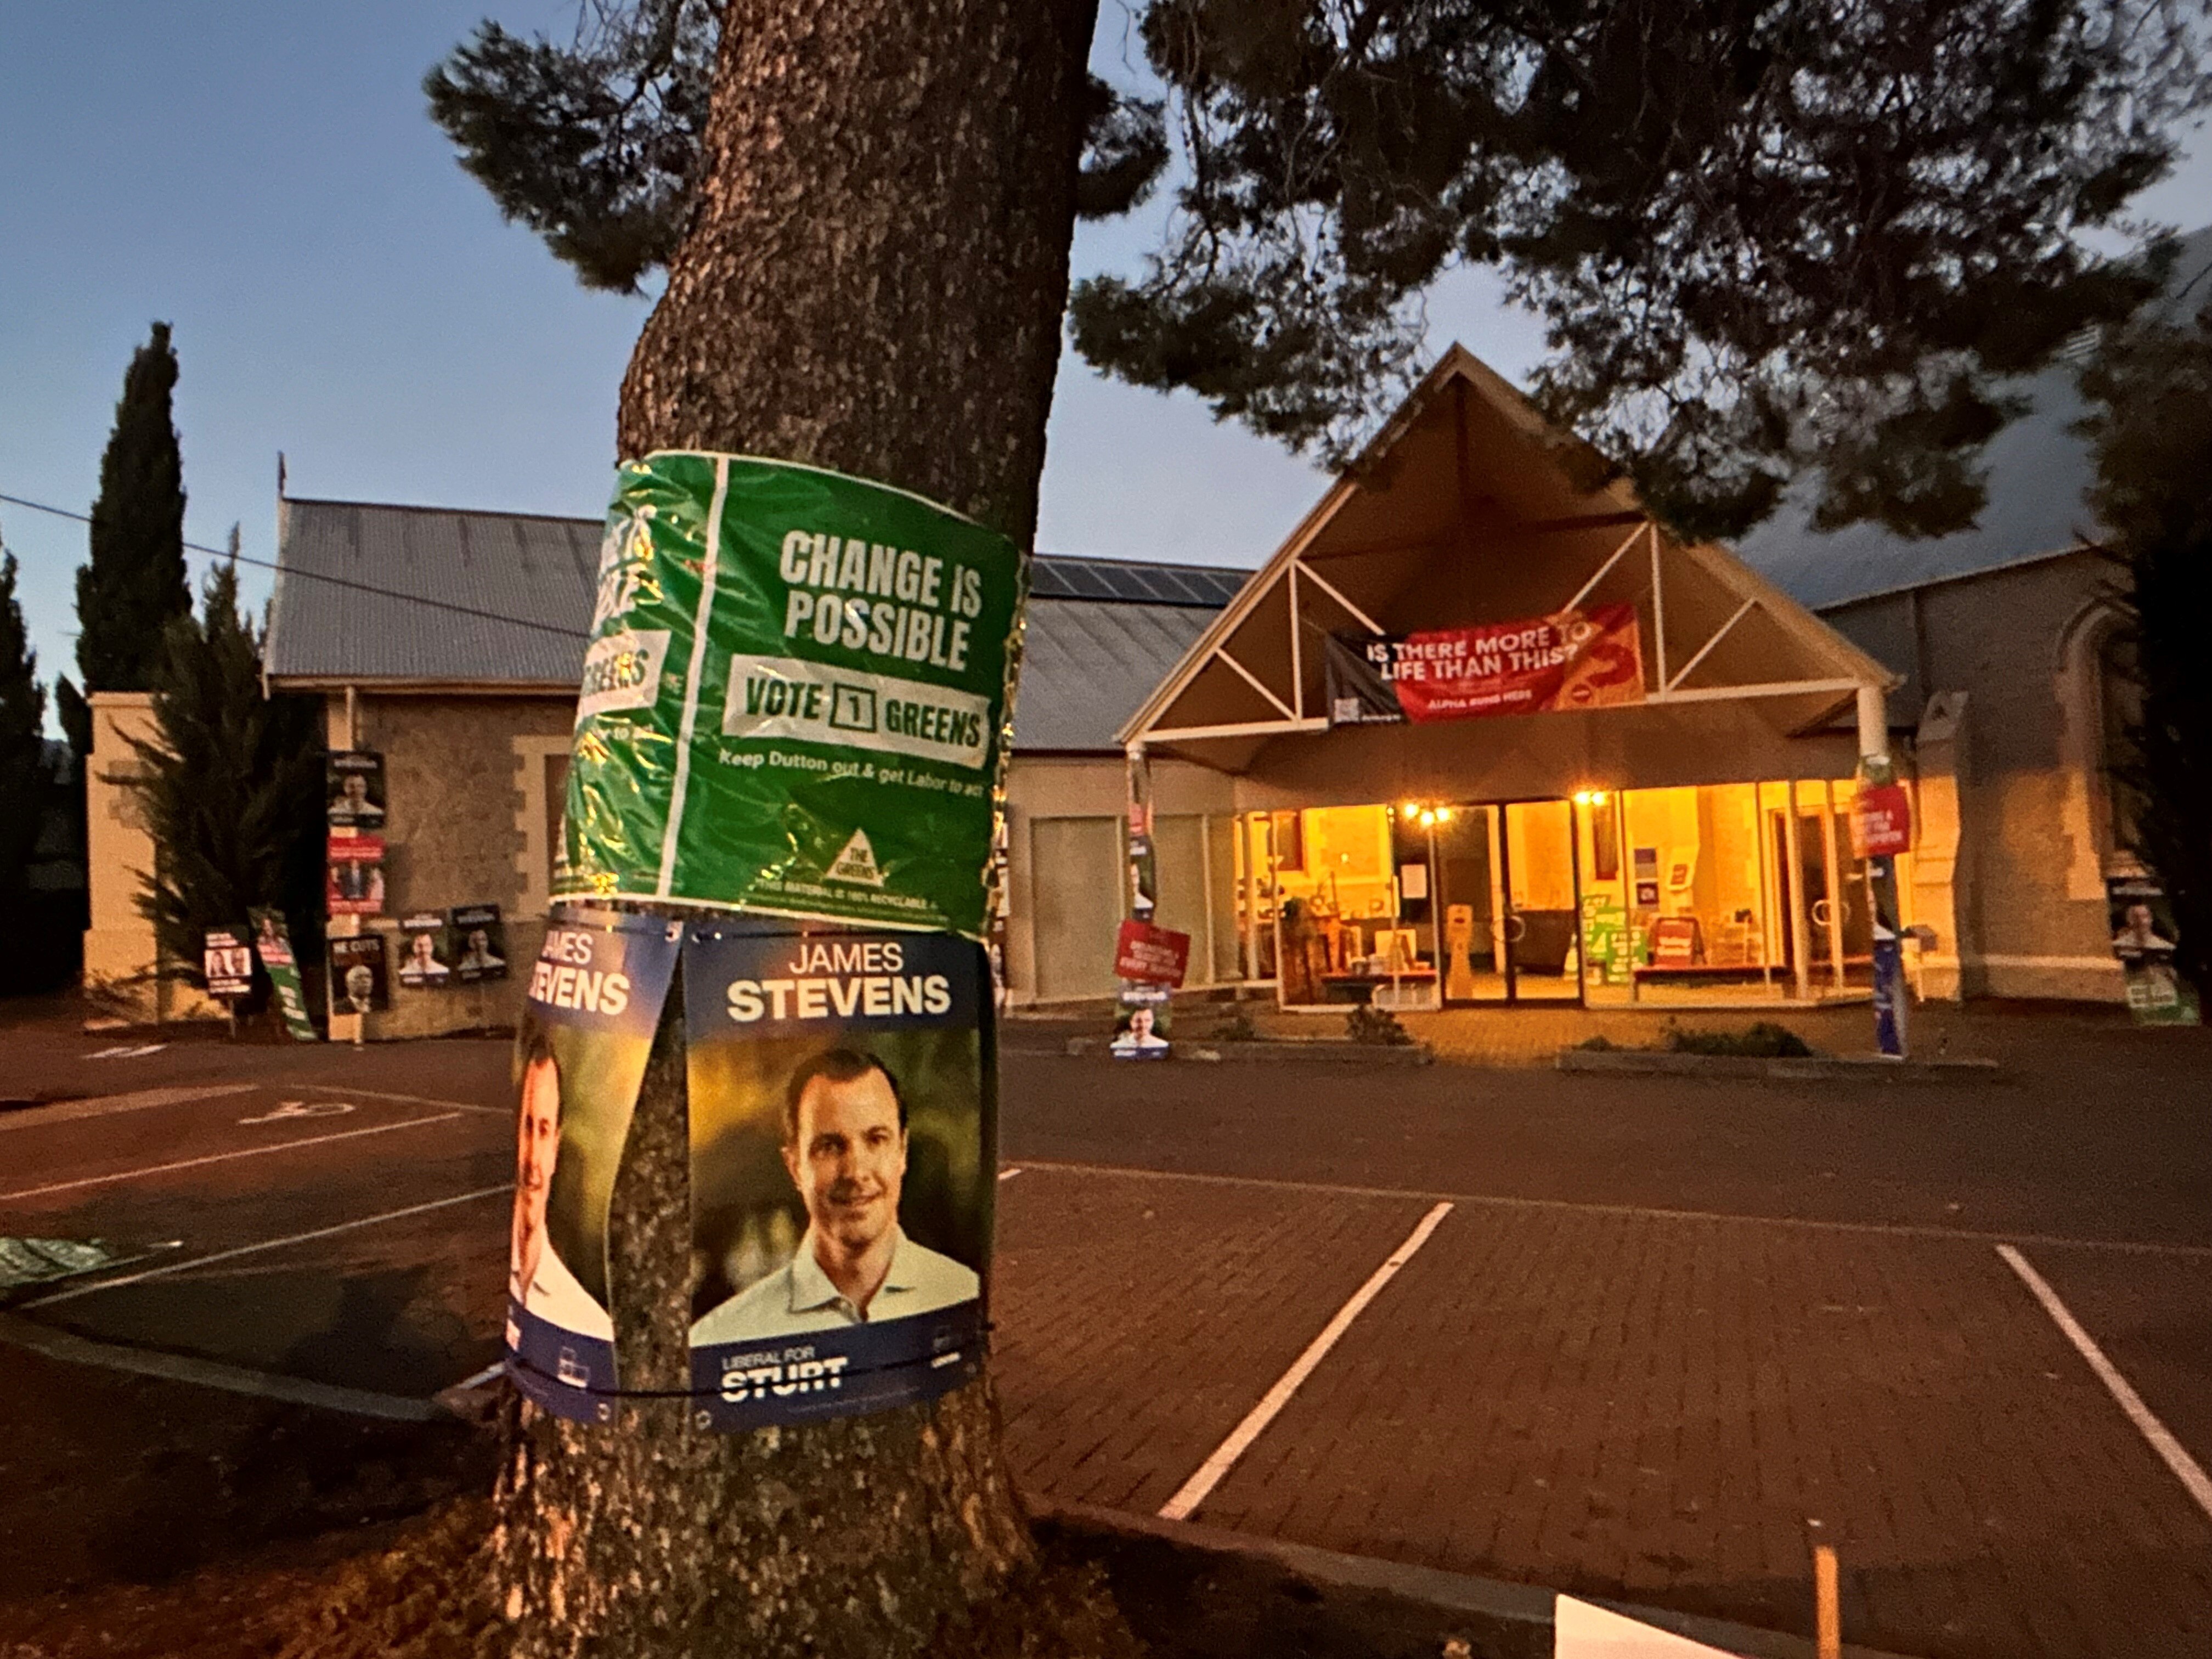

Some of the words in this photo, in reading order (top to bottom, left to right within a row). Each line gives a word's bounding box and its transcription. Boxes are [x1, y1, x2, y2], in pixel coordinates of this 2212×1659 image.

[780, 530, 943, 607] CHANGE
[950, 564, 982, 618] IS
[784, 590, 971, 672] POSSIBLE
[1367, 643, 1389, 663] IS
[1391, 640, 1468, 661] THERE
[1475, 626, 1550, 655] MORE
[1556, 621, 1591, 644] TO
[1380, 660, 1426, 681] LIFE
[1432, 654, 1502, 680] THAN
[1509, 643, 1578, 672] THIS?
[746, 678, 823, 719] VOTE
[885, 699, 980, 748] GREENS
[719, 748, 765, 769] Keep
[769, 751, 828, 771] Dutton
[832, 761, 860, 778] out
[862, 763, 874, 778] &
[879, 768, 905, 785] get
[907, 770, 947, 791] Labor
[789, 942, 904, 974] JAMES
[727, 974, 952, 1023] STEVENS
[721, 1351, 781, 1370] LIBERAL
[784, 1344, 816, 1363] FOR
[721, 1356, 848, 1403] STURT
